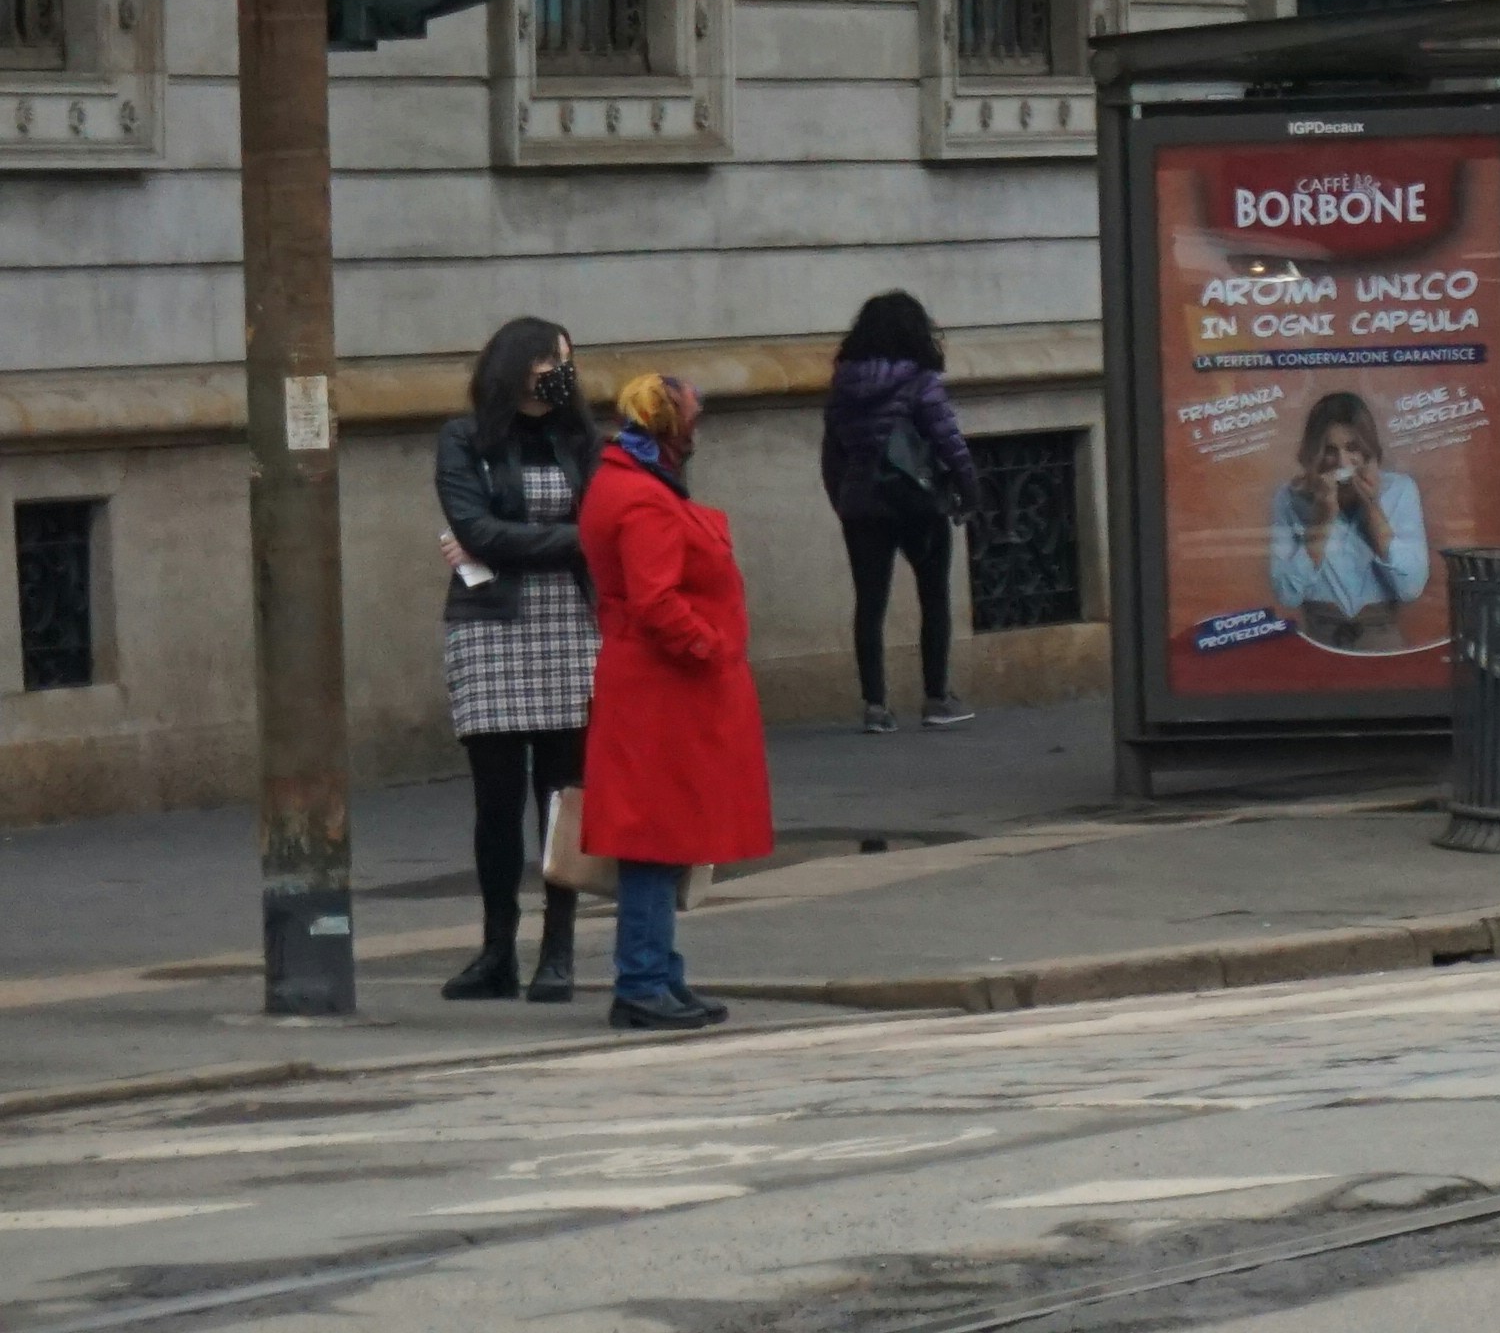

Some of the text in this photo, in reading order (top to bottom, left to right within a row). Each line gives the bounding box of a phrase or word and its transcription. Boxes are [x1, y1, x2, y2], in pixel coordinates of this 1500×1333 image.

[1288, 120, 1365, 136] IGPDecaux
[1296, 174, 1350, 194] CAFFÈ
[1235, 182, 1428, 229] BORBONE
[1200, 269, 1480, 307] AROMA UNICO
[1200, 308, 1480, 340] IN OGNI CAPSULA
[1195, 347, 1477, 369] LA PERFETTA CONSERVAZIONE GARANTISCE
[1177, 384, 1285, 423] FRAGRANZA
[1394, 386, 1451, 412] IGIENE
[1211, 406, 1278, 435] AROMA
[1198, 619, 1288, 650] PROTEZIONE
